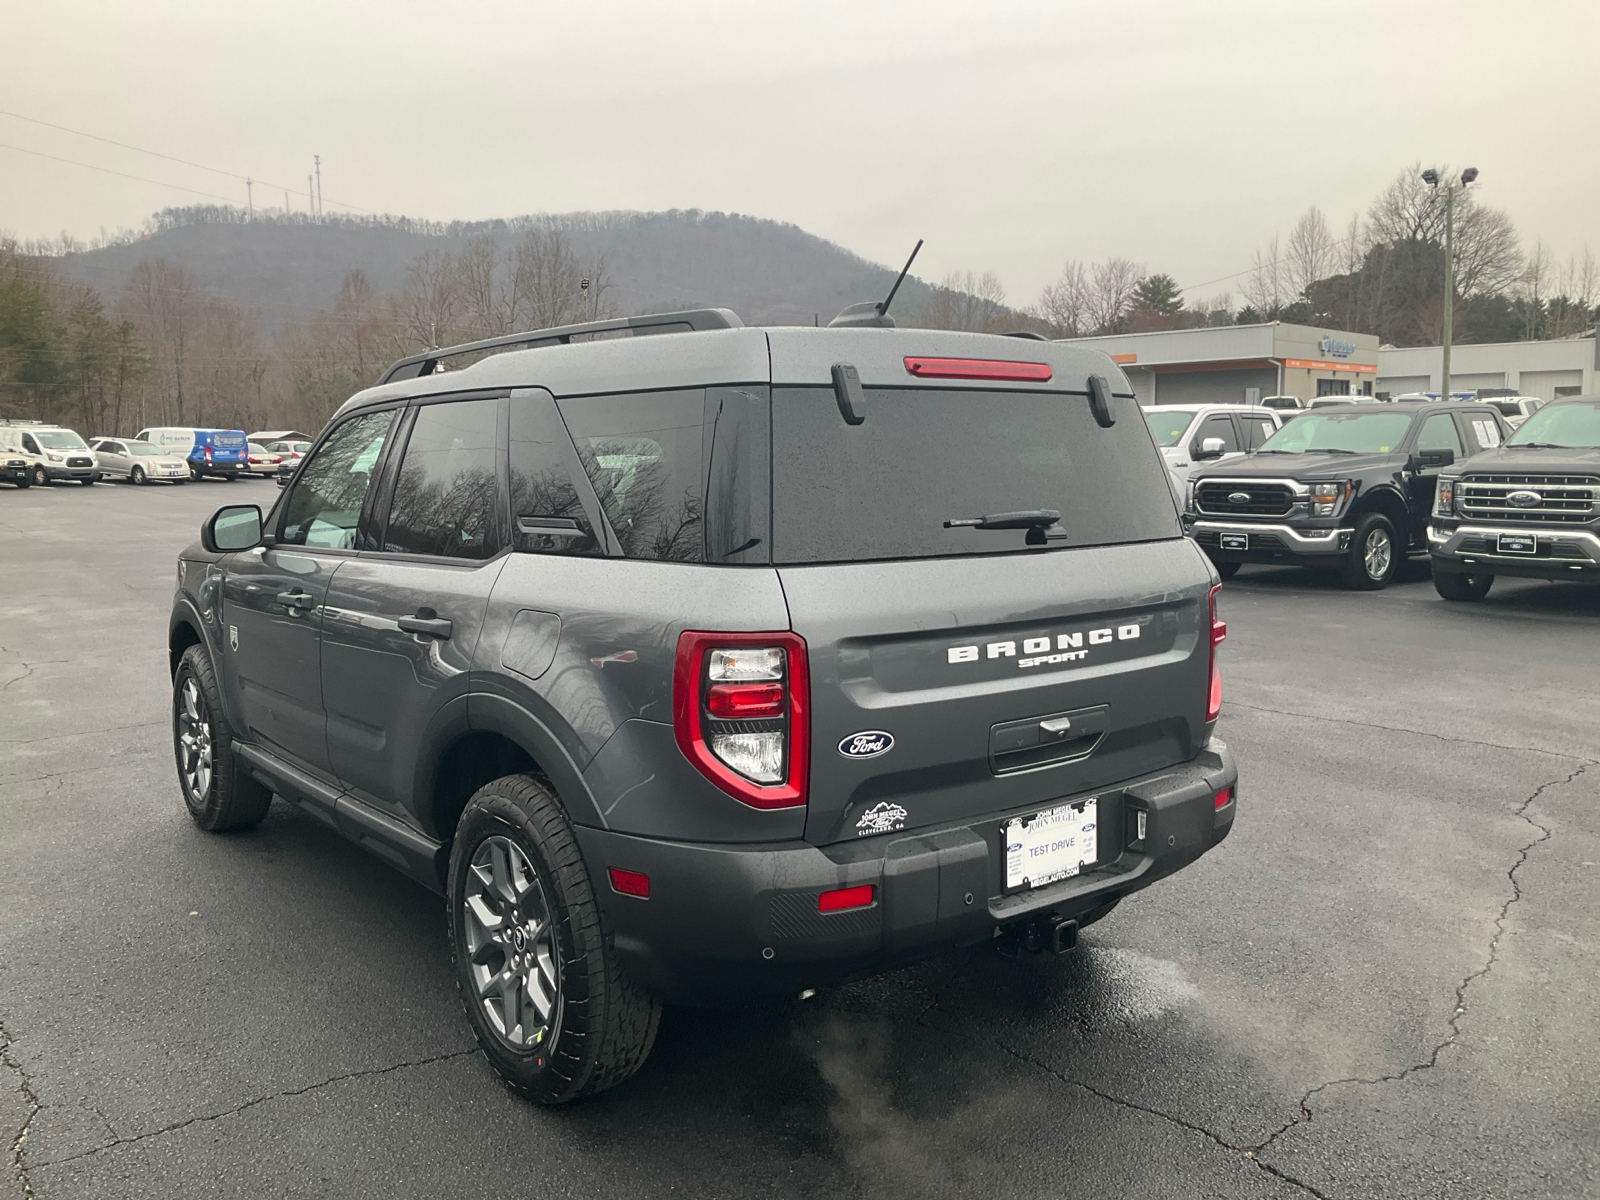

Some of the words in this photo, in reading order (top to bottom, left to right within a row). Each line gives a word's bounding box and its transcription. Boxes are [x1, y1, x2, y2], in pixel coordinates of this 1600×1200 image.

[948, 624, 1140, 664] BRONCO
[1018, 650, 1089, 668] SPORT
[849, 734, 885, 754] Ford
[1028, 819, 1049, 834] JOHN
[1051, 812, 1077, 824] MEGEL
[1029, 844, 1049, 857] TEST
[1051, 837, 1076, 852] DRIVE
[1030, 867, 1079, 888] MEGELAUTO.COM
